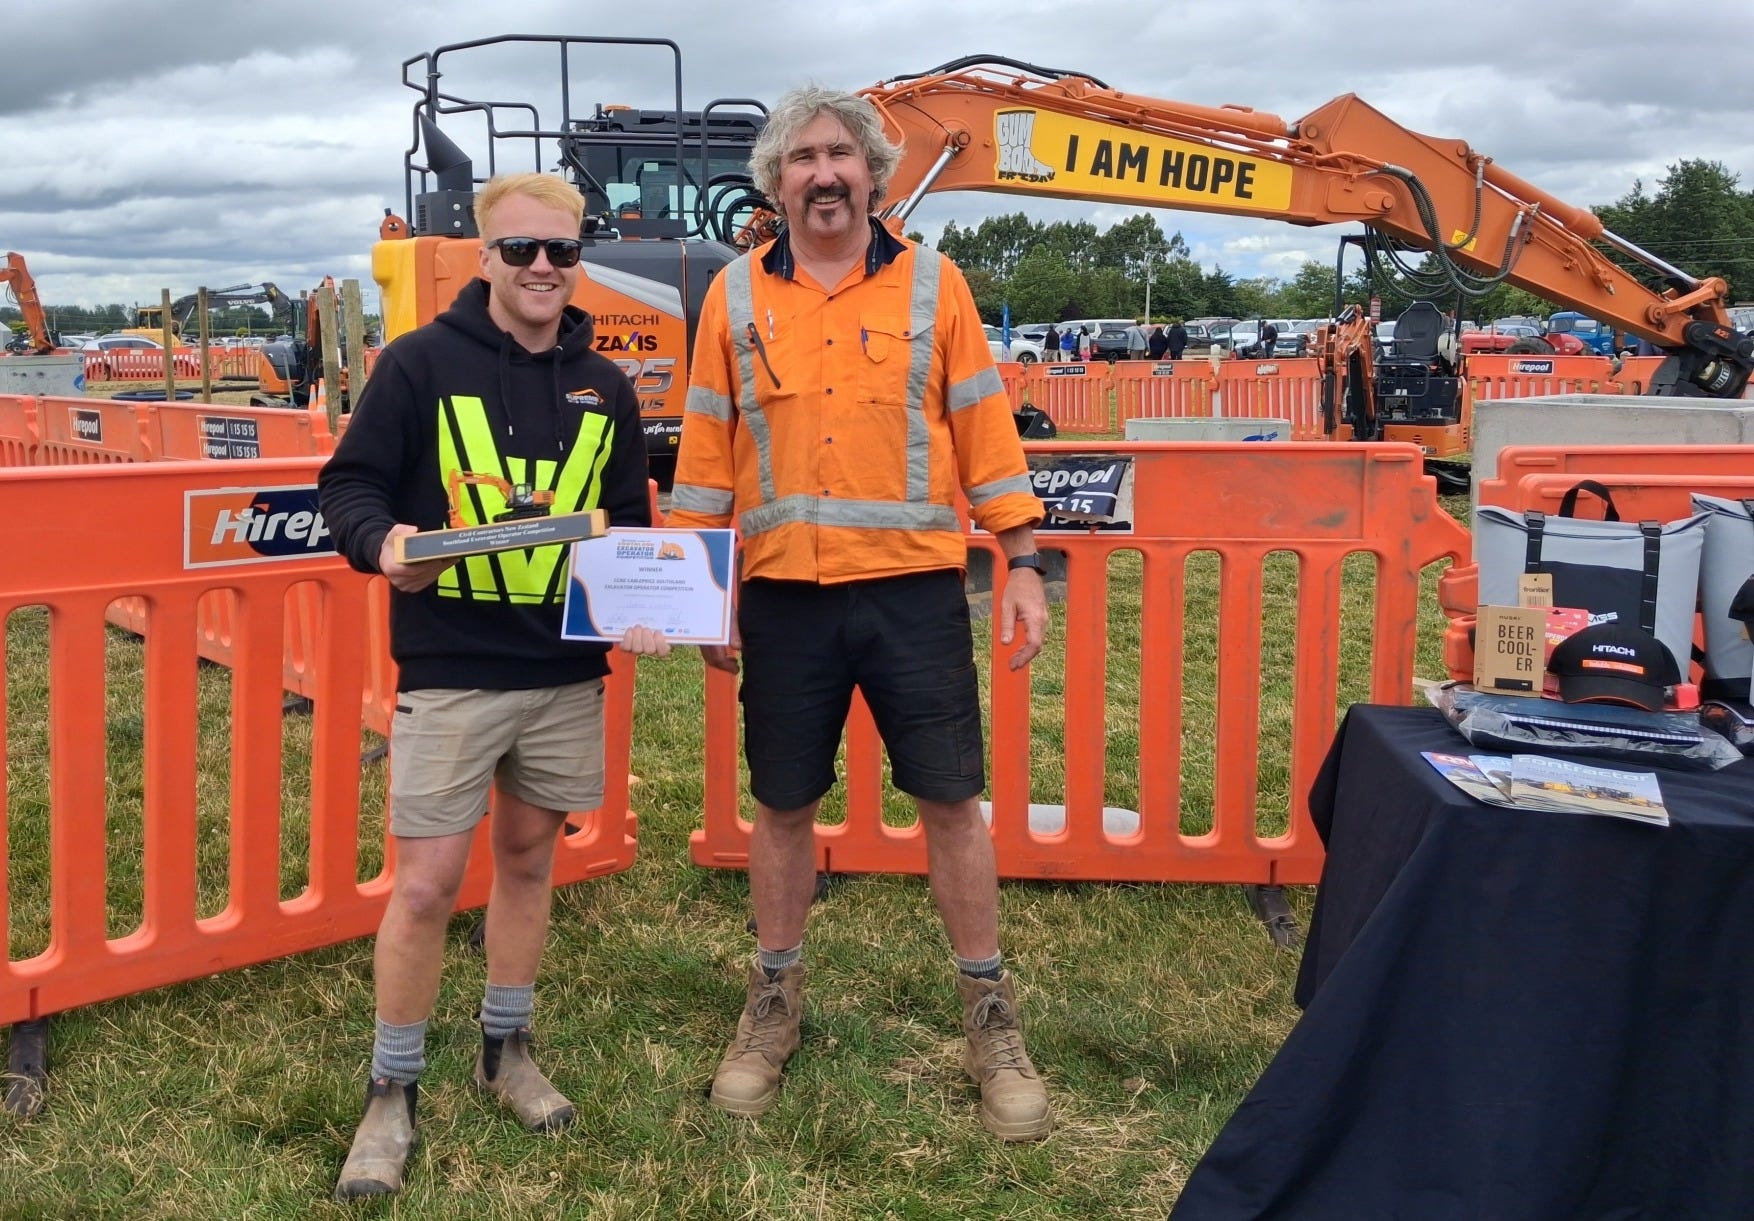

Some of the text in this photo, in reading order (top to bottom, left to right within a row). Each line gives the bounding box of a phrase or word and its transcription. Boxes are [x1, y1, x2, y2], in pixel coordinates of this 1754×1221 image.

[996, 113, 1036, 147] GUM
[1065, 134, 1256, 199] I AM HOPE
[998, 171, 1056, 183] FRIDAY
[592, 314, 659, 325] HITACHI
[596, 331, 658, 351] ZAXIS
[1512, 362, 1550, 372] Hirepool
[72, 416, 99, 437] Hirepool
[201, 420, 225, 435] Hirepool
[203, 444, 227, 456] Hirepool
[442, 538, 470, 546] Southland
[497, 531, 522, 540] Operator
[523, 526, 556, 536] Competition
[458, 530, 472, 538] Civil
[472, 527, 504, 537] Contractors
[517, 522, 539, 531] Zealand
[1498, 624, 1534, 640] BEER
[1497, 640, 1537, 656] COOL-
[1592, 644, 1636, 657] HITACHI
[1516, 657, 1533, 672] ER
[1517, 755, 1650, 781] contractor
